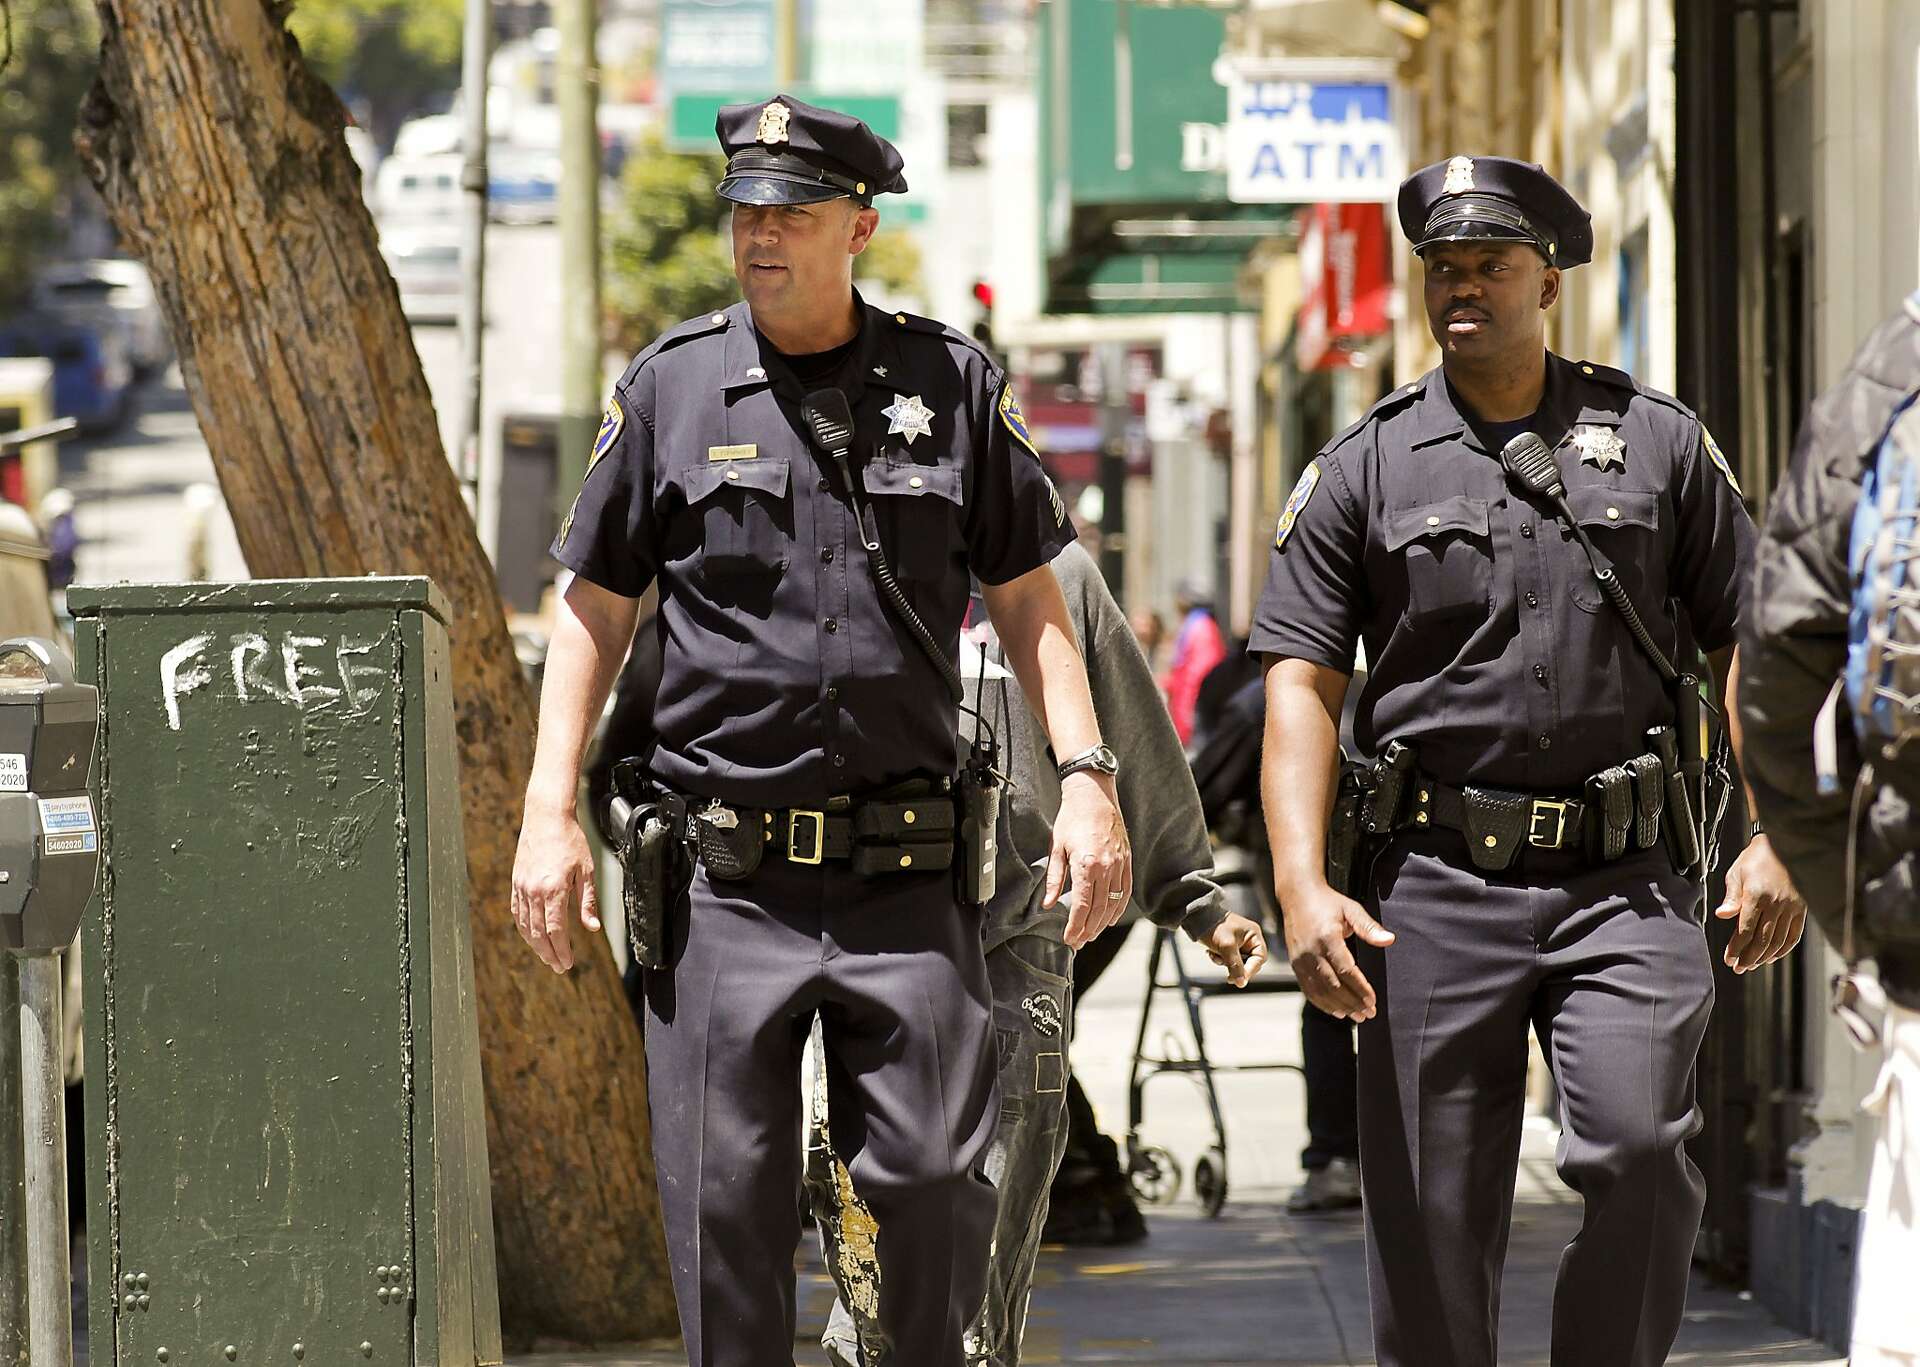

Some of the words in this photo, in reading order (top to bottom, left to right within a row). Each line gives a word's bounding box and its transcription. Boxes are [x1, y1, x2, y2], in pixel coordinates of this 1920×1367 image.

[1249, 142, 1385, 180] ATM
[1587, 444, 1619, 455] POLICE
[160, 630, 392, 731] FREE
[0, 758, 18, 770] 546
